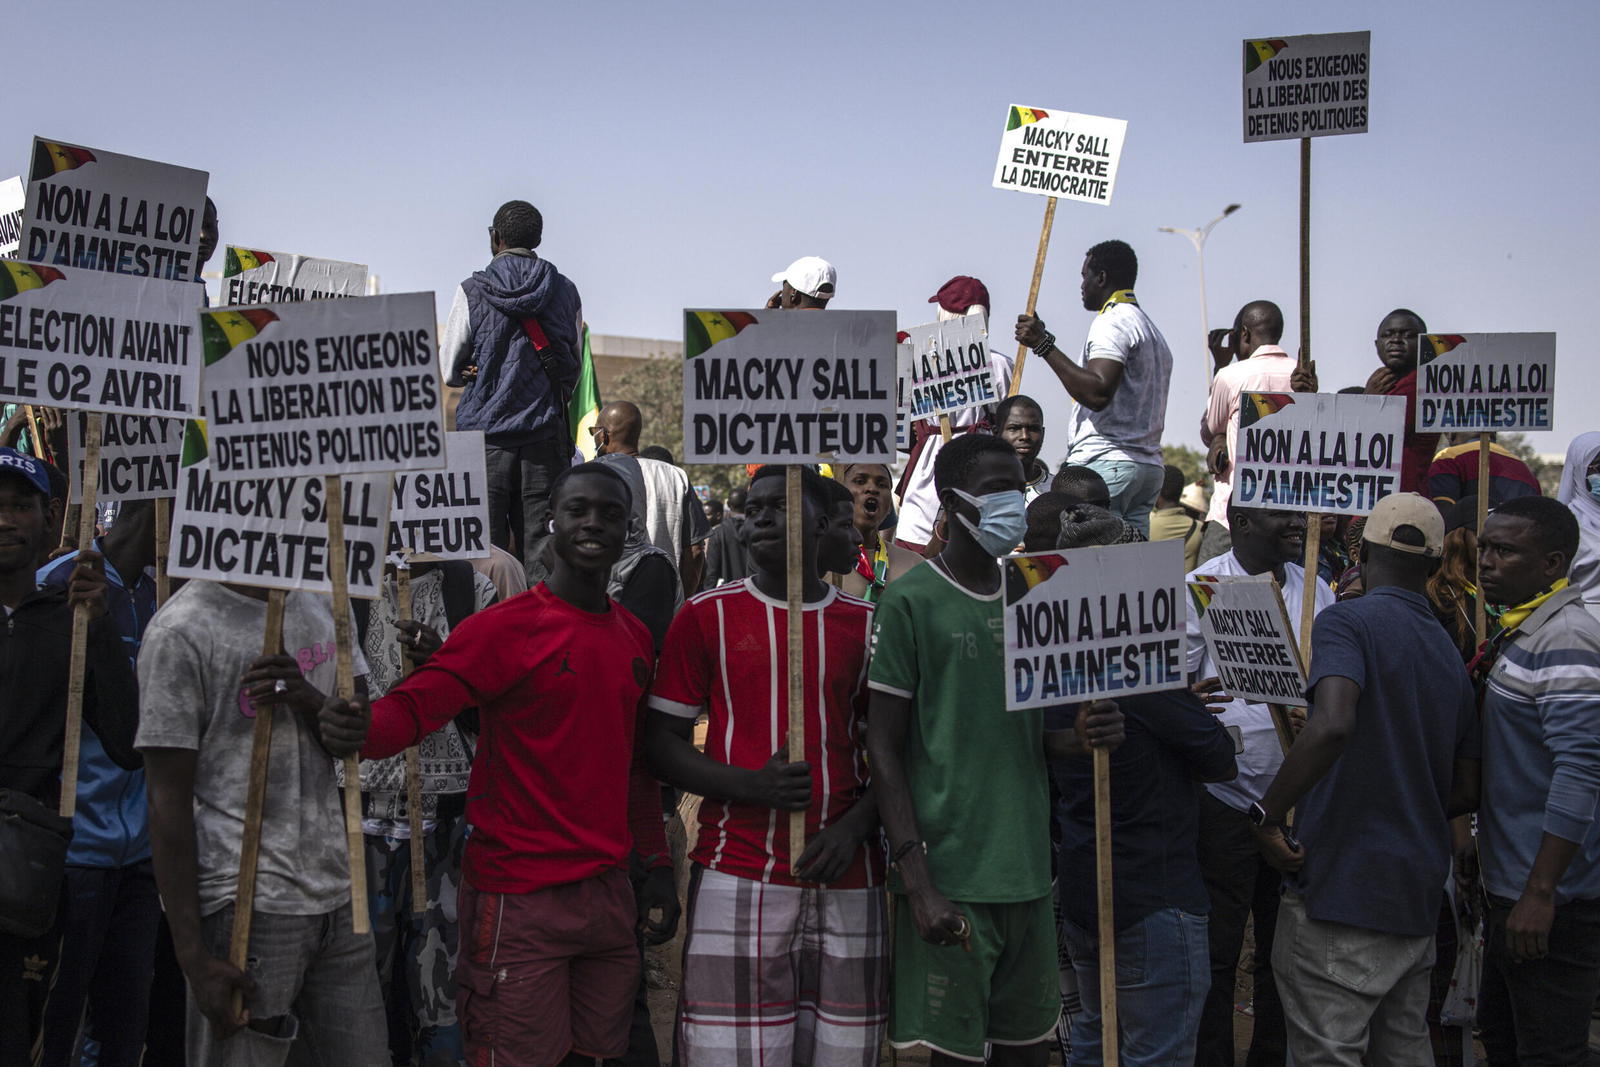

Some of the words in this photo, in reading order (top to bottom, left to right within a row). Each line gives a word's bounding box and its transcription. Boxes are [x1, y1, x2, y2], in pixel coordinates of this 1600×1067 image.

[1268, 58, 1302, 81] NOUS
[1305, 53, 1367, 78] EXIGEONS
[1248, 87, 1264, 109] LA
[1267, 81, 1339, 107] LIBERATION
[1343, 79, 1367, 101] DES
[1248, 111, 1299, 136] DETENUS
[1302, 106, 1367, 132] POLITIQUES
[1023, 126, 1074, 151] MACKY
[1075, 134, 1110, 157] SALL
[1012, 147, 1109, 177] ENTERRE
[1000, 165, 1018, 185] LA
[1021, 169, 1109, 200] DEMOCRATIE
[36, 182, 91, 227] NON
[94, 193, 110, 231] A
[118, 197, 147, 237] LA
[155, 203, 194, 244] LOI
[28, 227, 191, 282] D'AMNESTIE
[228, 279, 305, 306] ELECTION
[0, 304, 114, 359] ELECTION
[120, 320, 191, 366] AVANT
[246, 339, 310, 378] NOUS
[315, 329, 431, 373] EXIGEONS
[694, 358, 804, 400] MACKY
[812, 358, 887, 400] SALL
[922, 354, 933, 382] A
[934, 349, 957, 377] LA
[959, 342, 986, 372] LOI
[1425, 364, 1465, 393] NON
[1469, 364, 1482, 393] A
[1488, 364, 1511, 393] LA
[1517, 363, 1547, 393] LOI
[0, 357, 38, 397] LE
[48, 362, 91, 402] 02
[99, 368, 186, 412] AVRIL
[212, 389, 243, 425] LA
[248, 378, 384, 423] LIBERATION
[391, 374, 436, 412] DES
[1422, 398, 1548, 428] D'AMNESTIE
[215, 430, 312, 472] DETENUS
[317, 421, 441, 464] POLITIQUES
[693, 413, 889, 456] DICTATEUR
[1245, 428, 1292, 463] NON
[1296, 430, 1312, 465] A
[1319, 431, 1347, 467] LA
[1354, 432, 1394, 469] LOI
[185, 467, 297, 519] MACKY
[302, 477, 378, 528] SLL
[415, 472, 480, 508] SALL
[1016, 599, 1069, 649] NON
[1077, 597, 1094, 641] A
[1100, 593, 1132, 639] LA
[1138, 587, 1176, 634] LOI
[1208, 608, 1248, 636] MACKY
[1245, 610, 1280, 638] SALL
[1014, 638, 1181, 702] D'AMNESTIE
[1214, 640, 1293, 666] ENTERRE
[1219, 665, 1237, 690] LA
[1232, 667, 1305, 698] DEMOCRATIE
